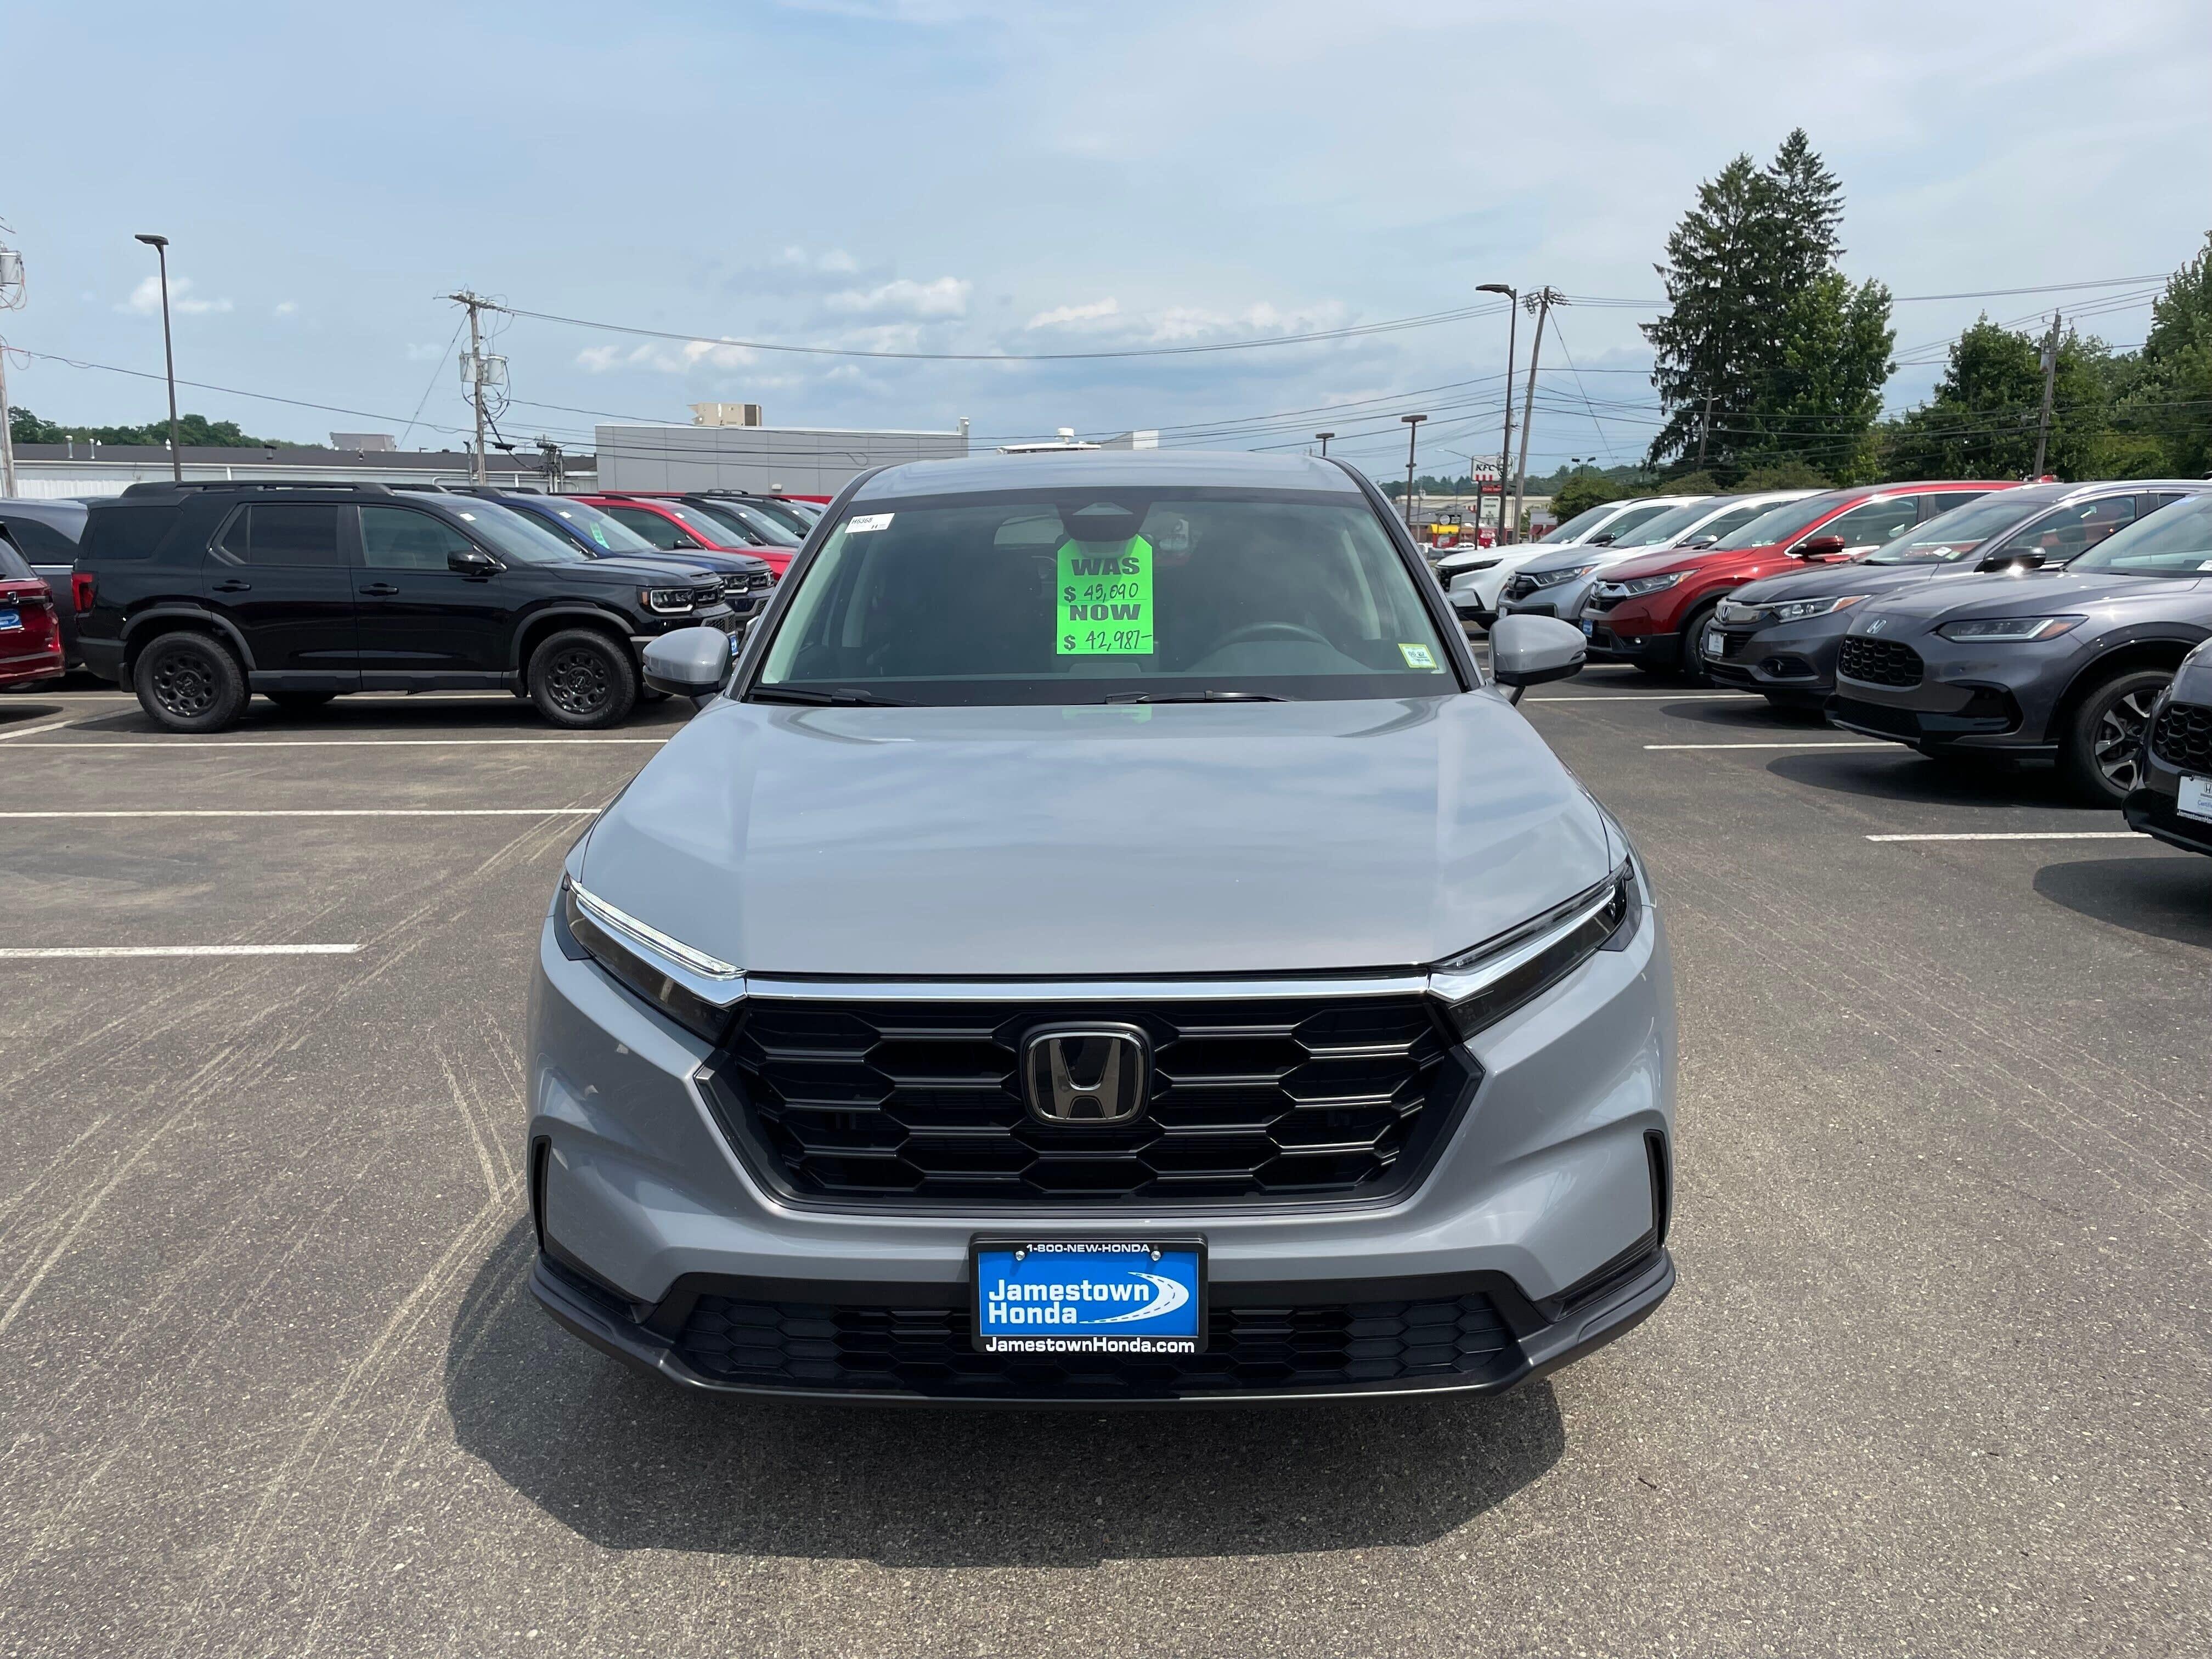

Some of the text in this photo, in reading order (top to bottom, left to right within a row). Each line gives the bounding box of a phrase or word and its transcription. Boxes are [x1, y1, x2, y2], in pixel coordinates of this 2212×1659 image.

[1071, 557, 1140, 576] WAS
[1064, 585, 1076, 603] $
[1070, 604, 1141, 621] NOW
[1064, 634, 1076, 651] $
[1026, 1244, 1150, 1253] 1-800-NEW-HONDA
[989, 1279, 1149, 1302] Jamestown
[989, 1301, 1077, 1324] Honda
[985, 1336, 1195, 1353] JamestownHonda.com
